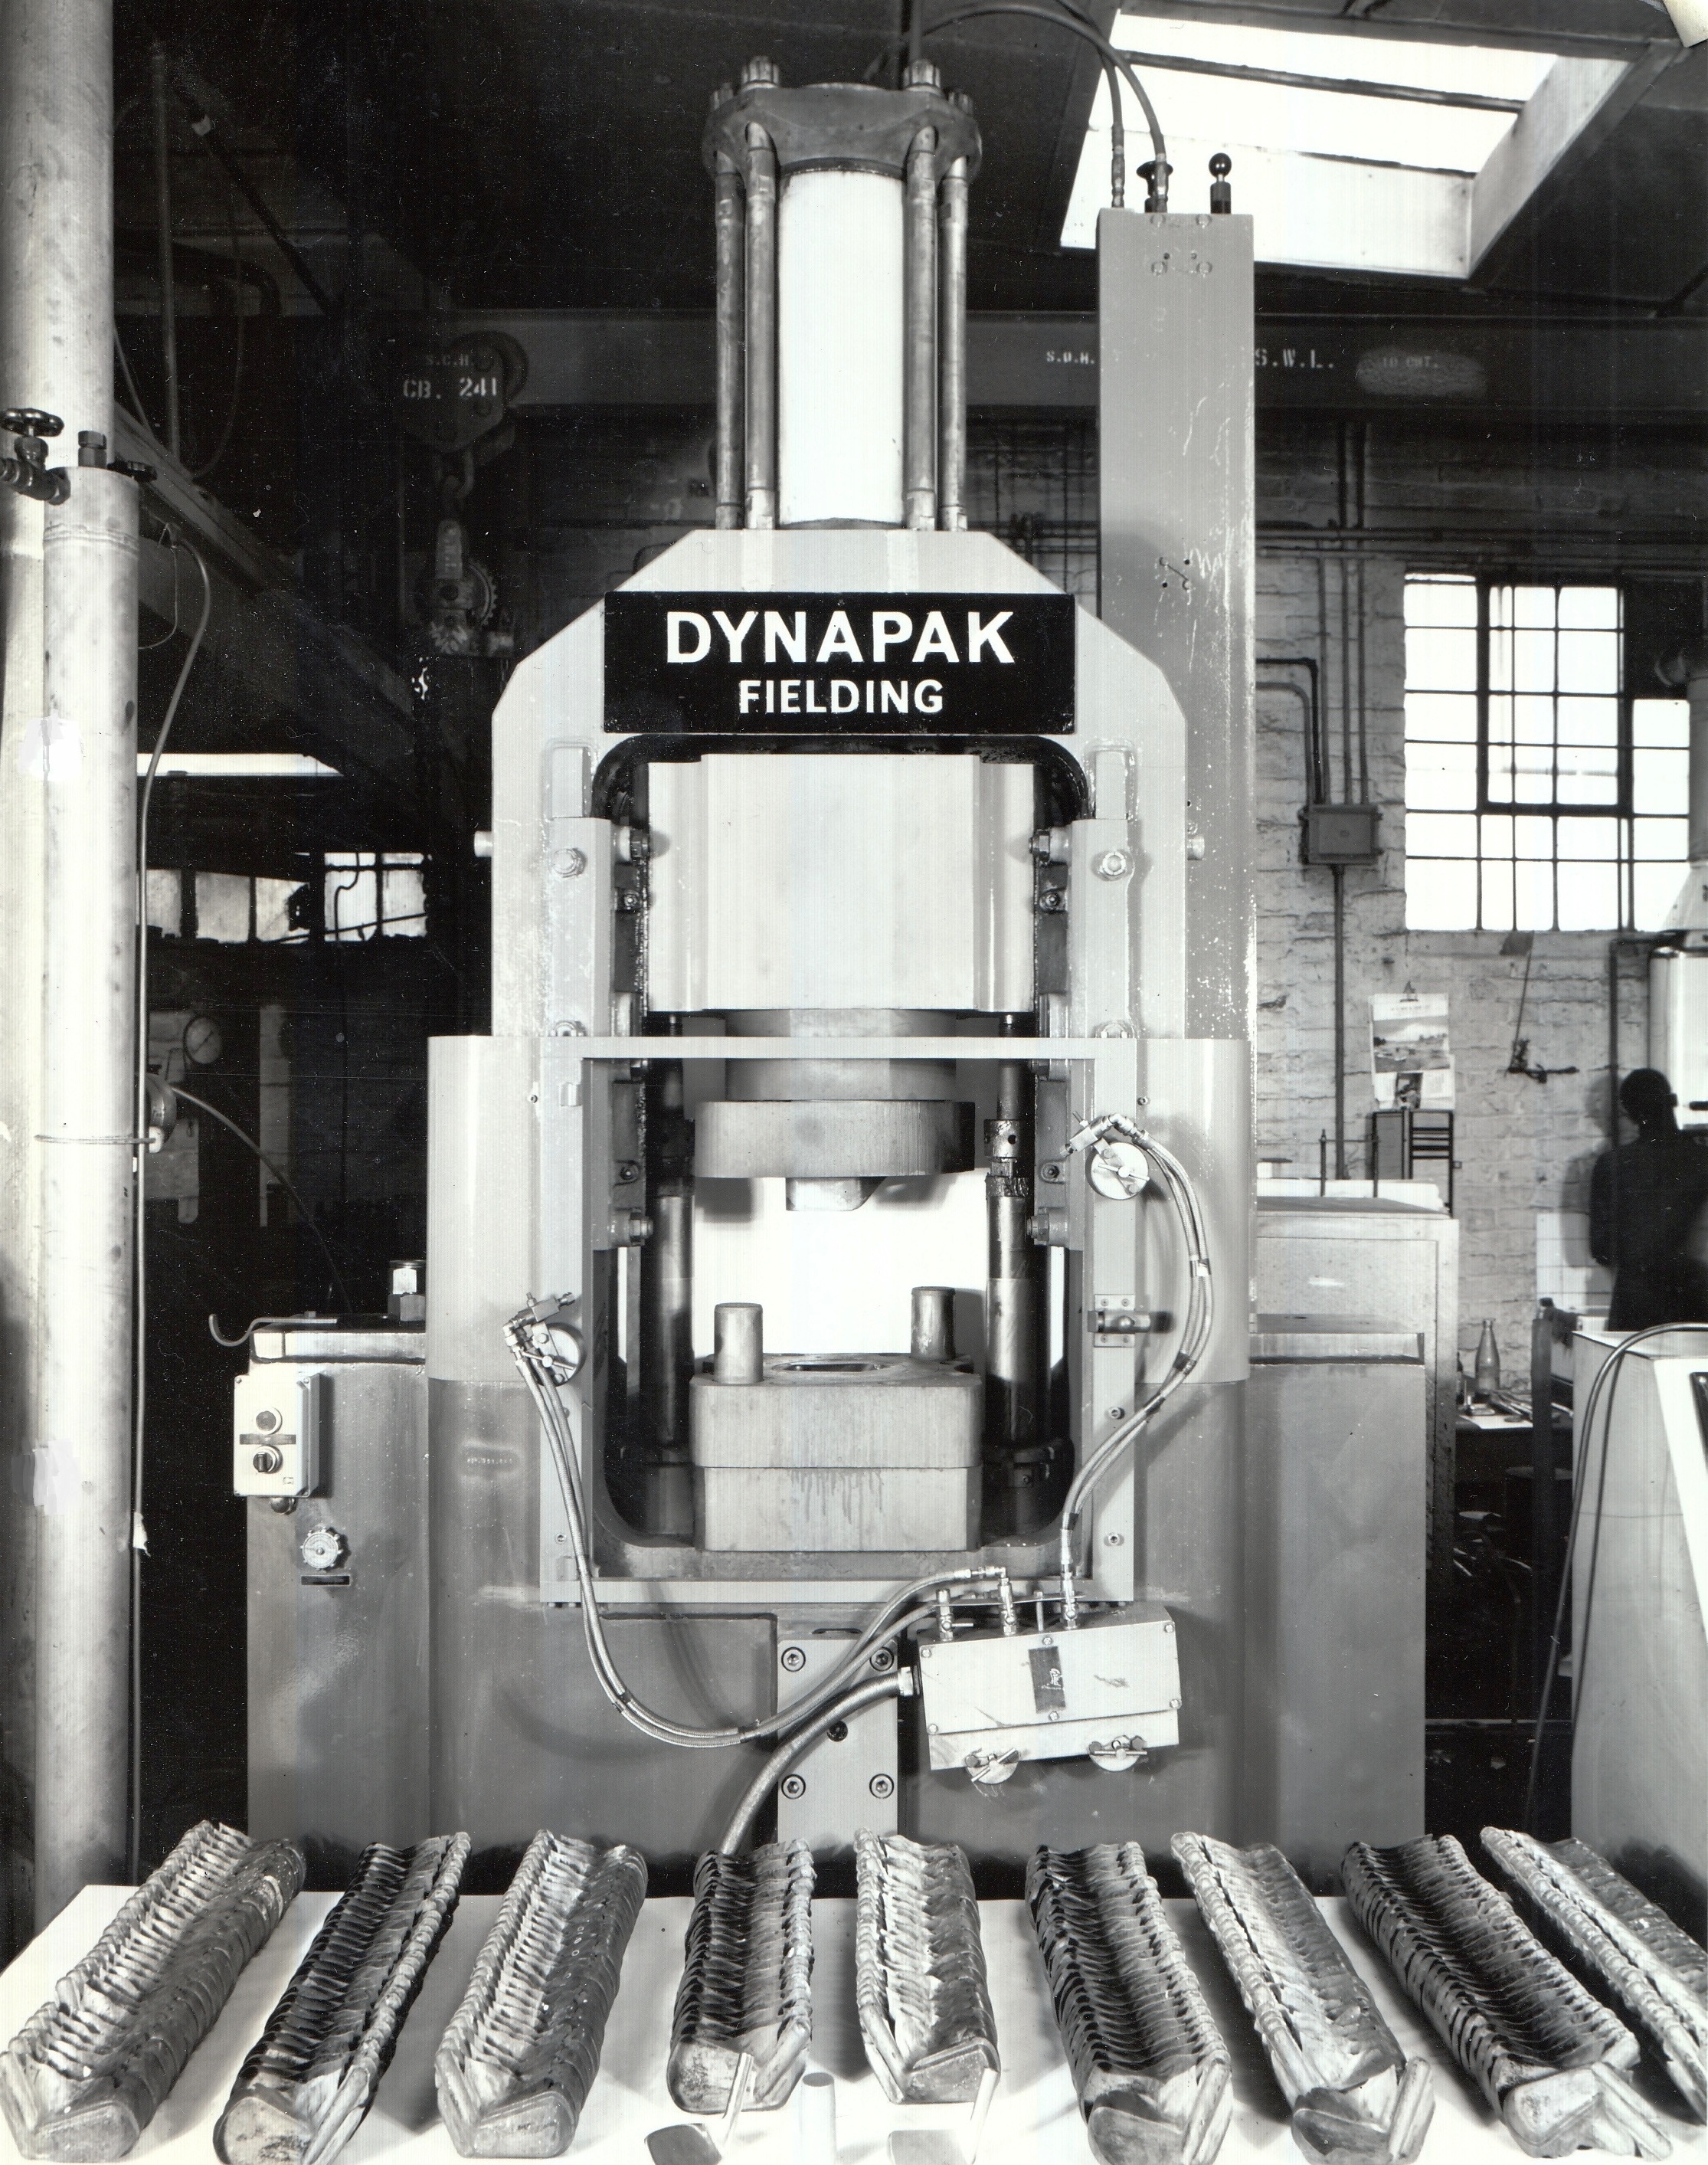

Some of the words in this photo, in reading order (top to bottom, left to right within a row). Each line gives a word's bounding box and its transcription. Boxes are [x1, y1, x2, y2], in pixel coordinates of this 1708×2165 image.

[1254, 348, 1334, 368] S.W.L.
[459, 378, 497, 397] 241
[666, 611, 1014, 663] DYNAPAK
[739, 679, 943, 713] FIELDING
